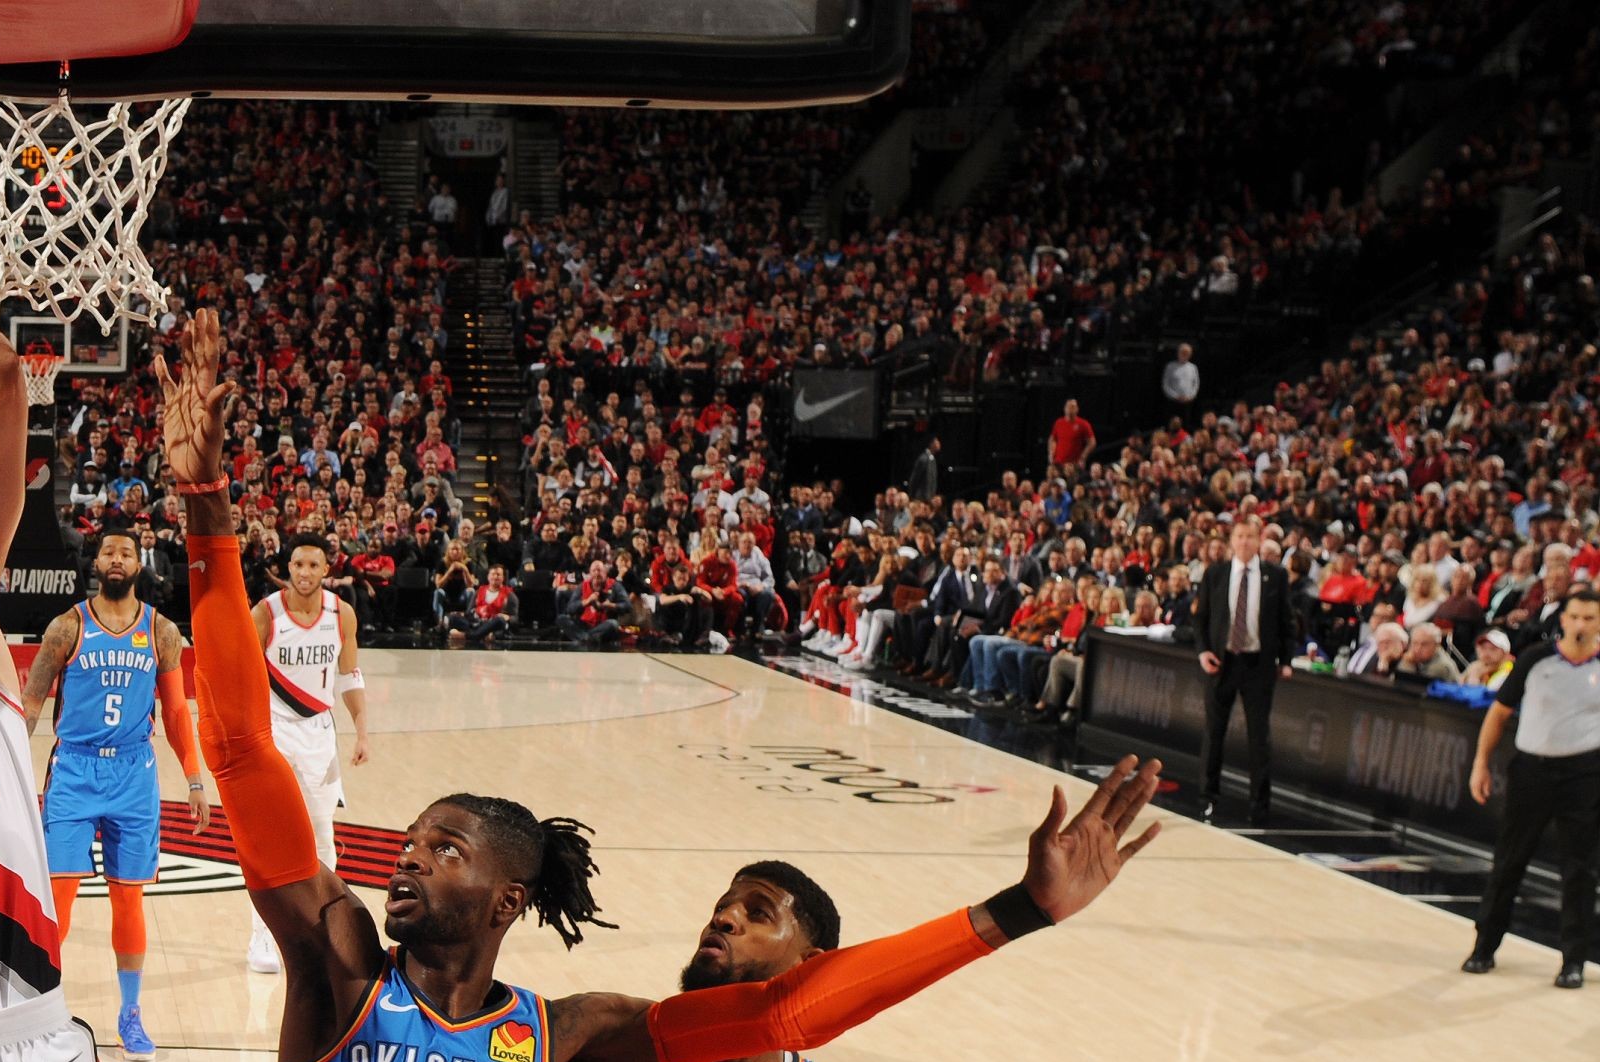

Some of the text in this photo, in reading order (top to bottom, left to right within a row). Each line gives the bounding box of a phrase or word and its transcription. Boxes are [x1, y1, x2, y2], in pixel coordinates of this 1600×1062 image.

[10, 568, 77, 595] PLAYOFFS
[79, 649, 155, 673] OKLAHOMA
[279, 644, 335, 666] BLAZERS
[101, 670, 133, 688] CITY
[321, 667, 328, 689] 1
[104, 692, 123, 727] 5
[98, 747, 117, 758] OKC
